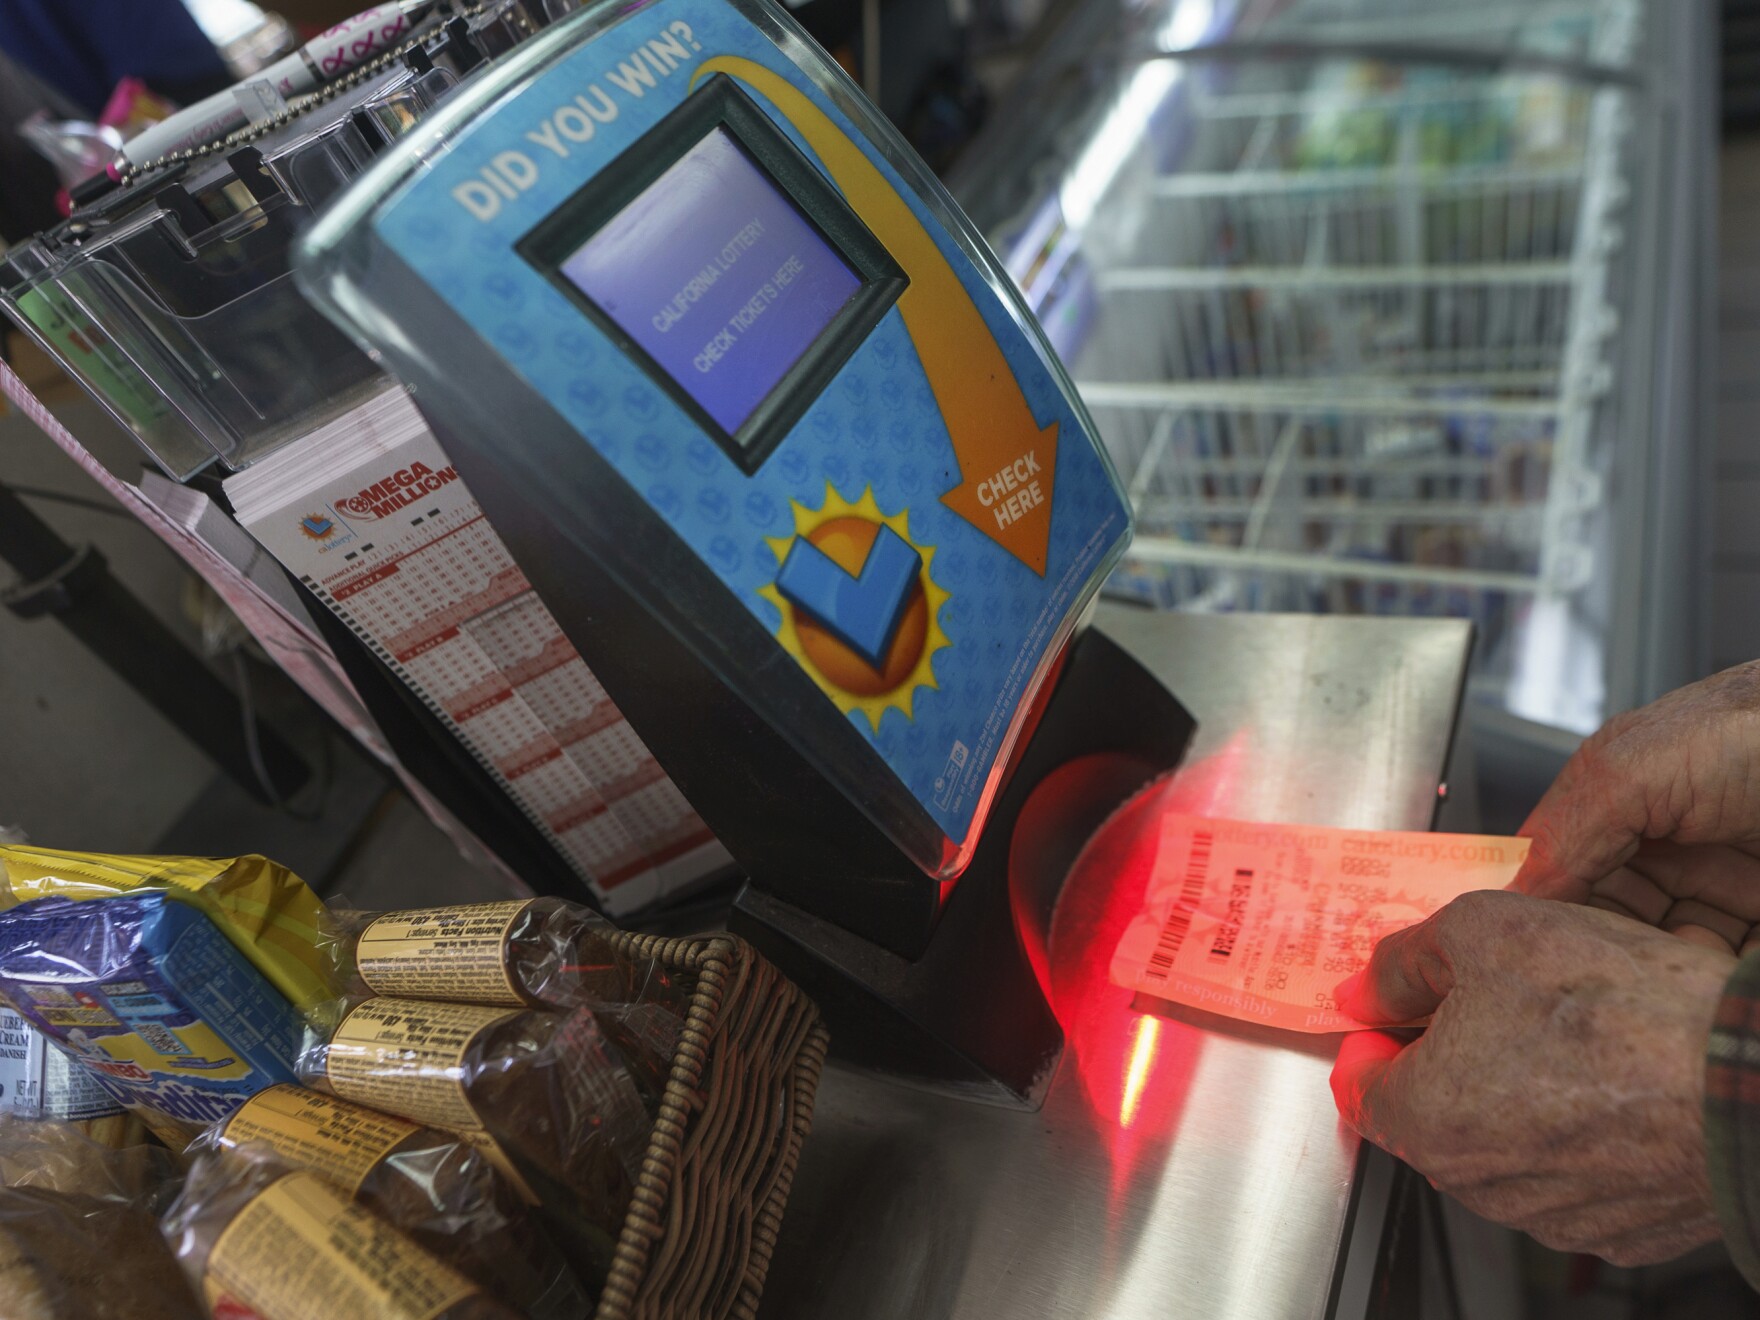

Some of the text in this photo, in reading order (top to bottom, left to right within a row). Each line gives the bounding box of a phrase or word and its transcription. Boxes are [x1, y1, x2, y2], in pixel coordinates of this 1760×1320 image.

[452, 20, 703, 223] DID YOU WIN?
[651, 218, 767, 333] CALIFORNIA LOTTERY
[693, 254, 804, 374] CHECK TICKETS HERE
[360, 461, 432, 504] MEGA
[976, 449, 1042, 507] CHECK
[992, 480, 1045, 531] HERE
[440, 927, 463, 935] Facts
[465, 926, 502, 936] Nutrition
[1174, 977, 1278, 1019] responsibly
